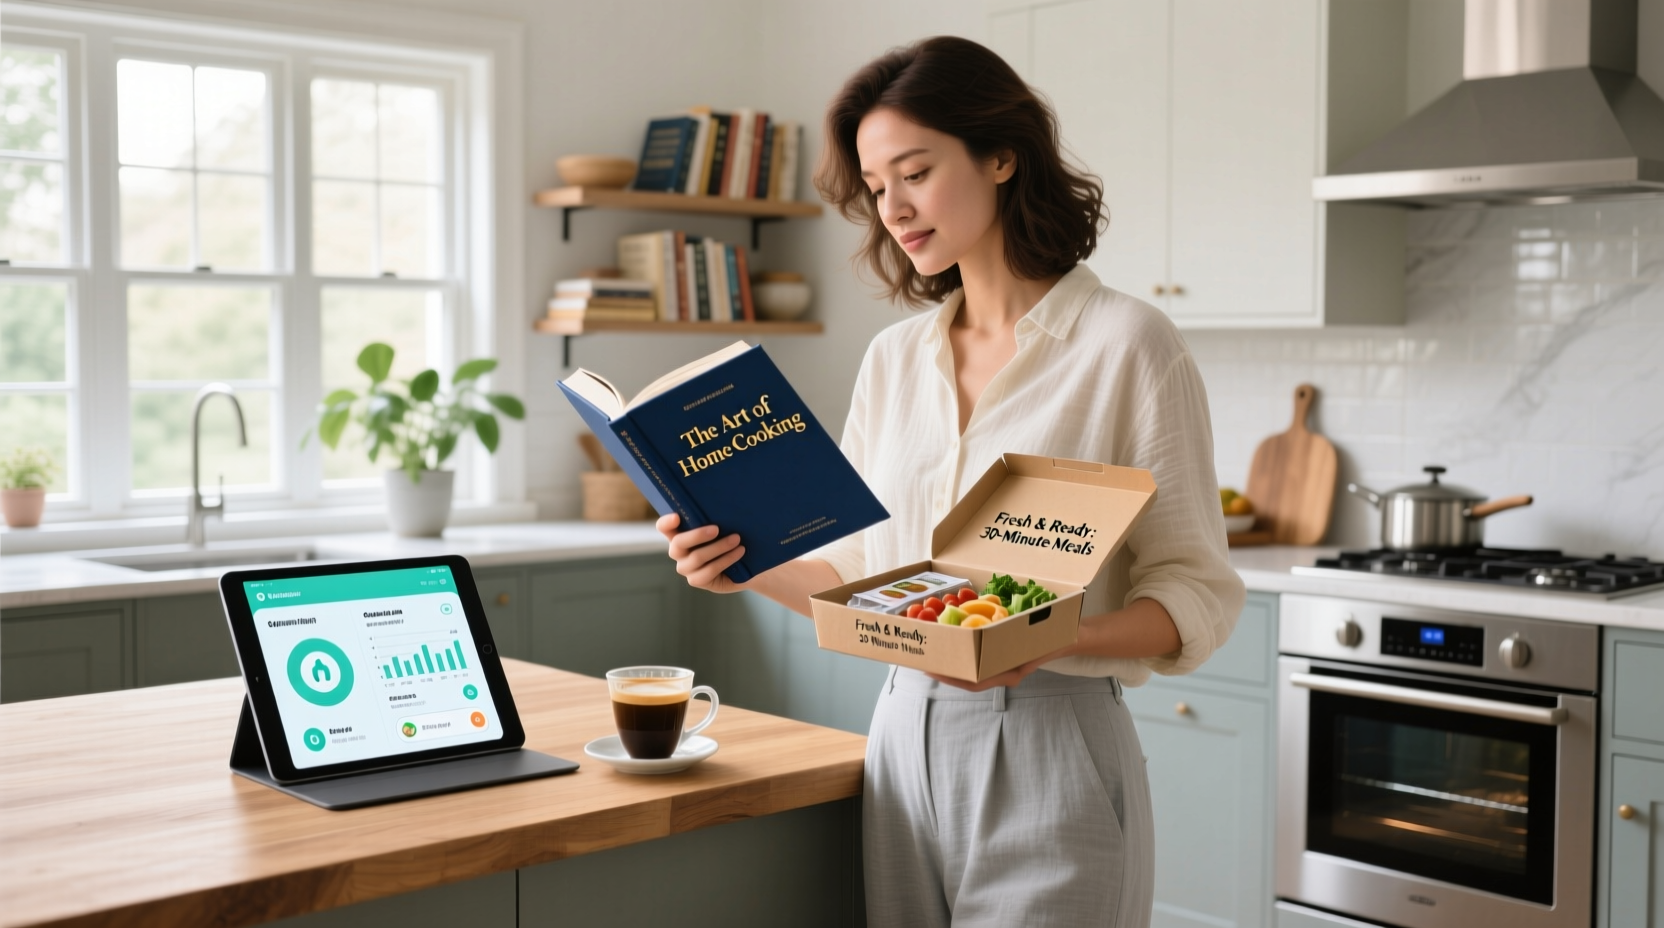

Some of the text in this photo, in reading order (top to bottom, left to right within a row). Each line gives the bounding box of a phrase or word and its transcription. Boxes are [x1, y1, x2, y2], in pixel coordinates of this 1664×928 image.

[680, 426, 719, 449] The
[721, 408, 751, 433] Art
[752, 394, 772, 418] of
[677, 413, 806, 477] Home Cooking
[979, 526, 1095, 555] 30-Minute Meals
[994, 511, 1097, 538] Fresh & Ready:
